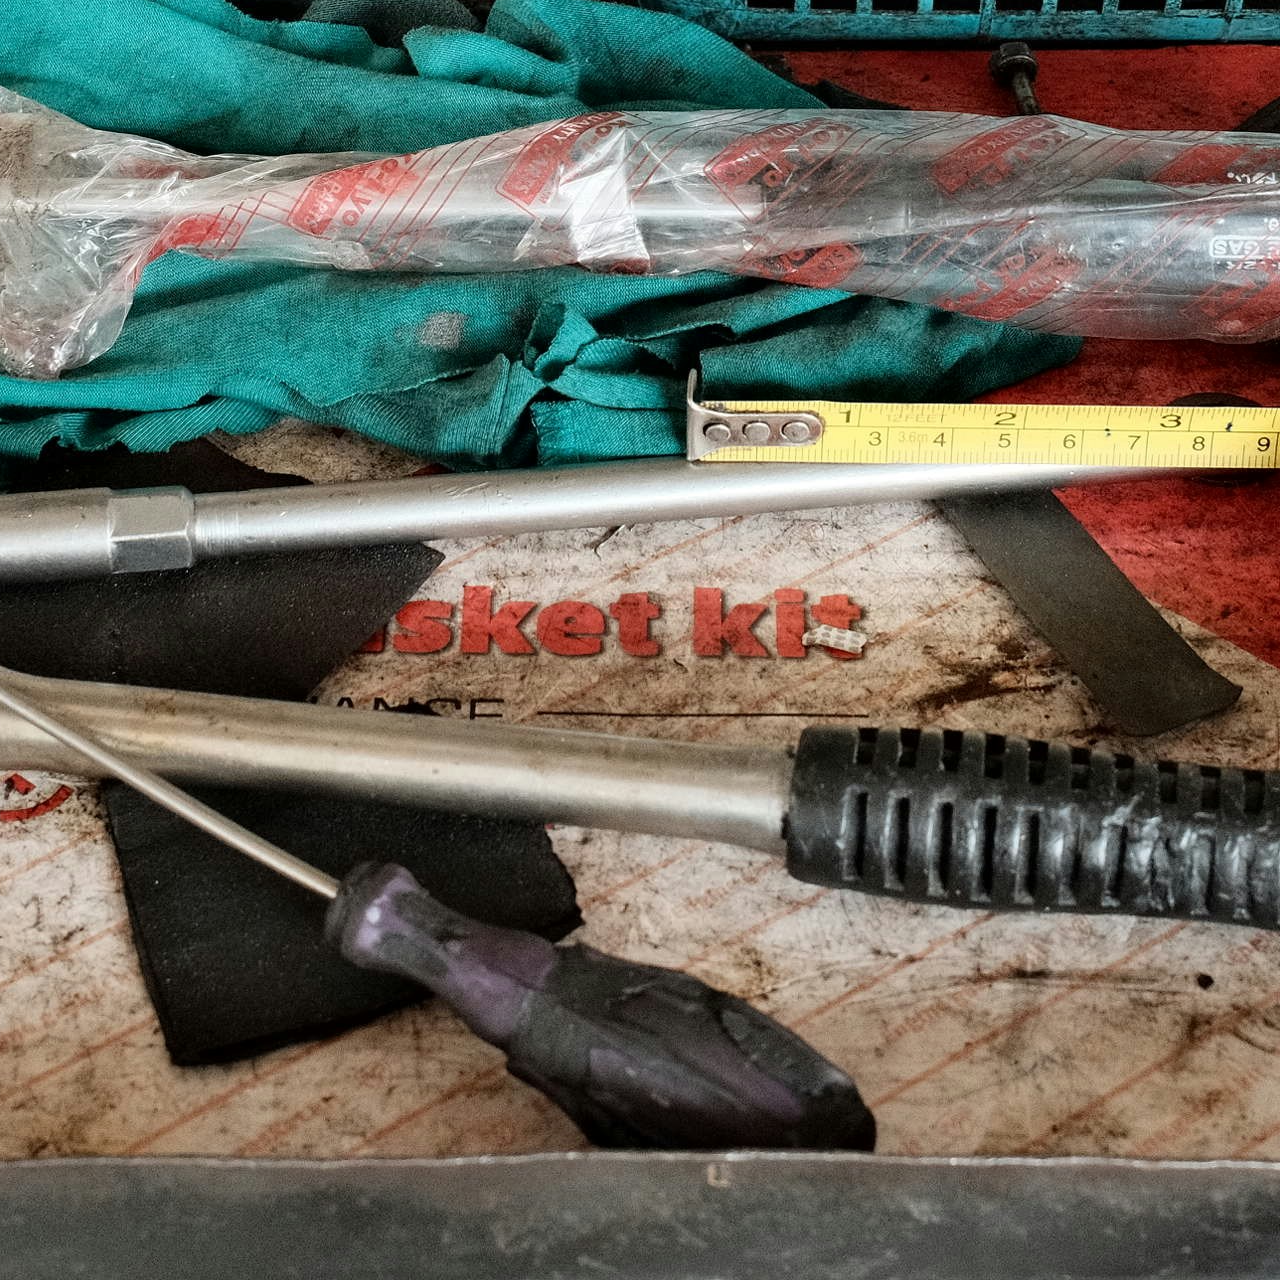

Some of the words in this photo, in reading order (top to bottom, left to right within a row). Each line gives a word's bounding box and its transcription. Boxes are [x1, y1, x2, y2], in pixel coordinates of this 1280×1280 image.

[1212, 239, 1261, 255] GAS
[839, 409, 852, 424] 1
[993, 411, 1017, 426] 2
[1159, 412, 1183, 429] 3
[868, 431, 882, 447] 3
[932, 432, 946, 447] 4
[997, 433, 1012, 448] 5
[1062, 434, 1077, 449] 6
[1127, 433, 1141, 450] 7
[1191, 435, 1206, 452] 8
[1256, 436, 1271, 453] 9
[358, 585, 659, 656] sket
